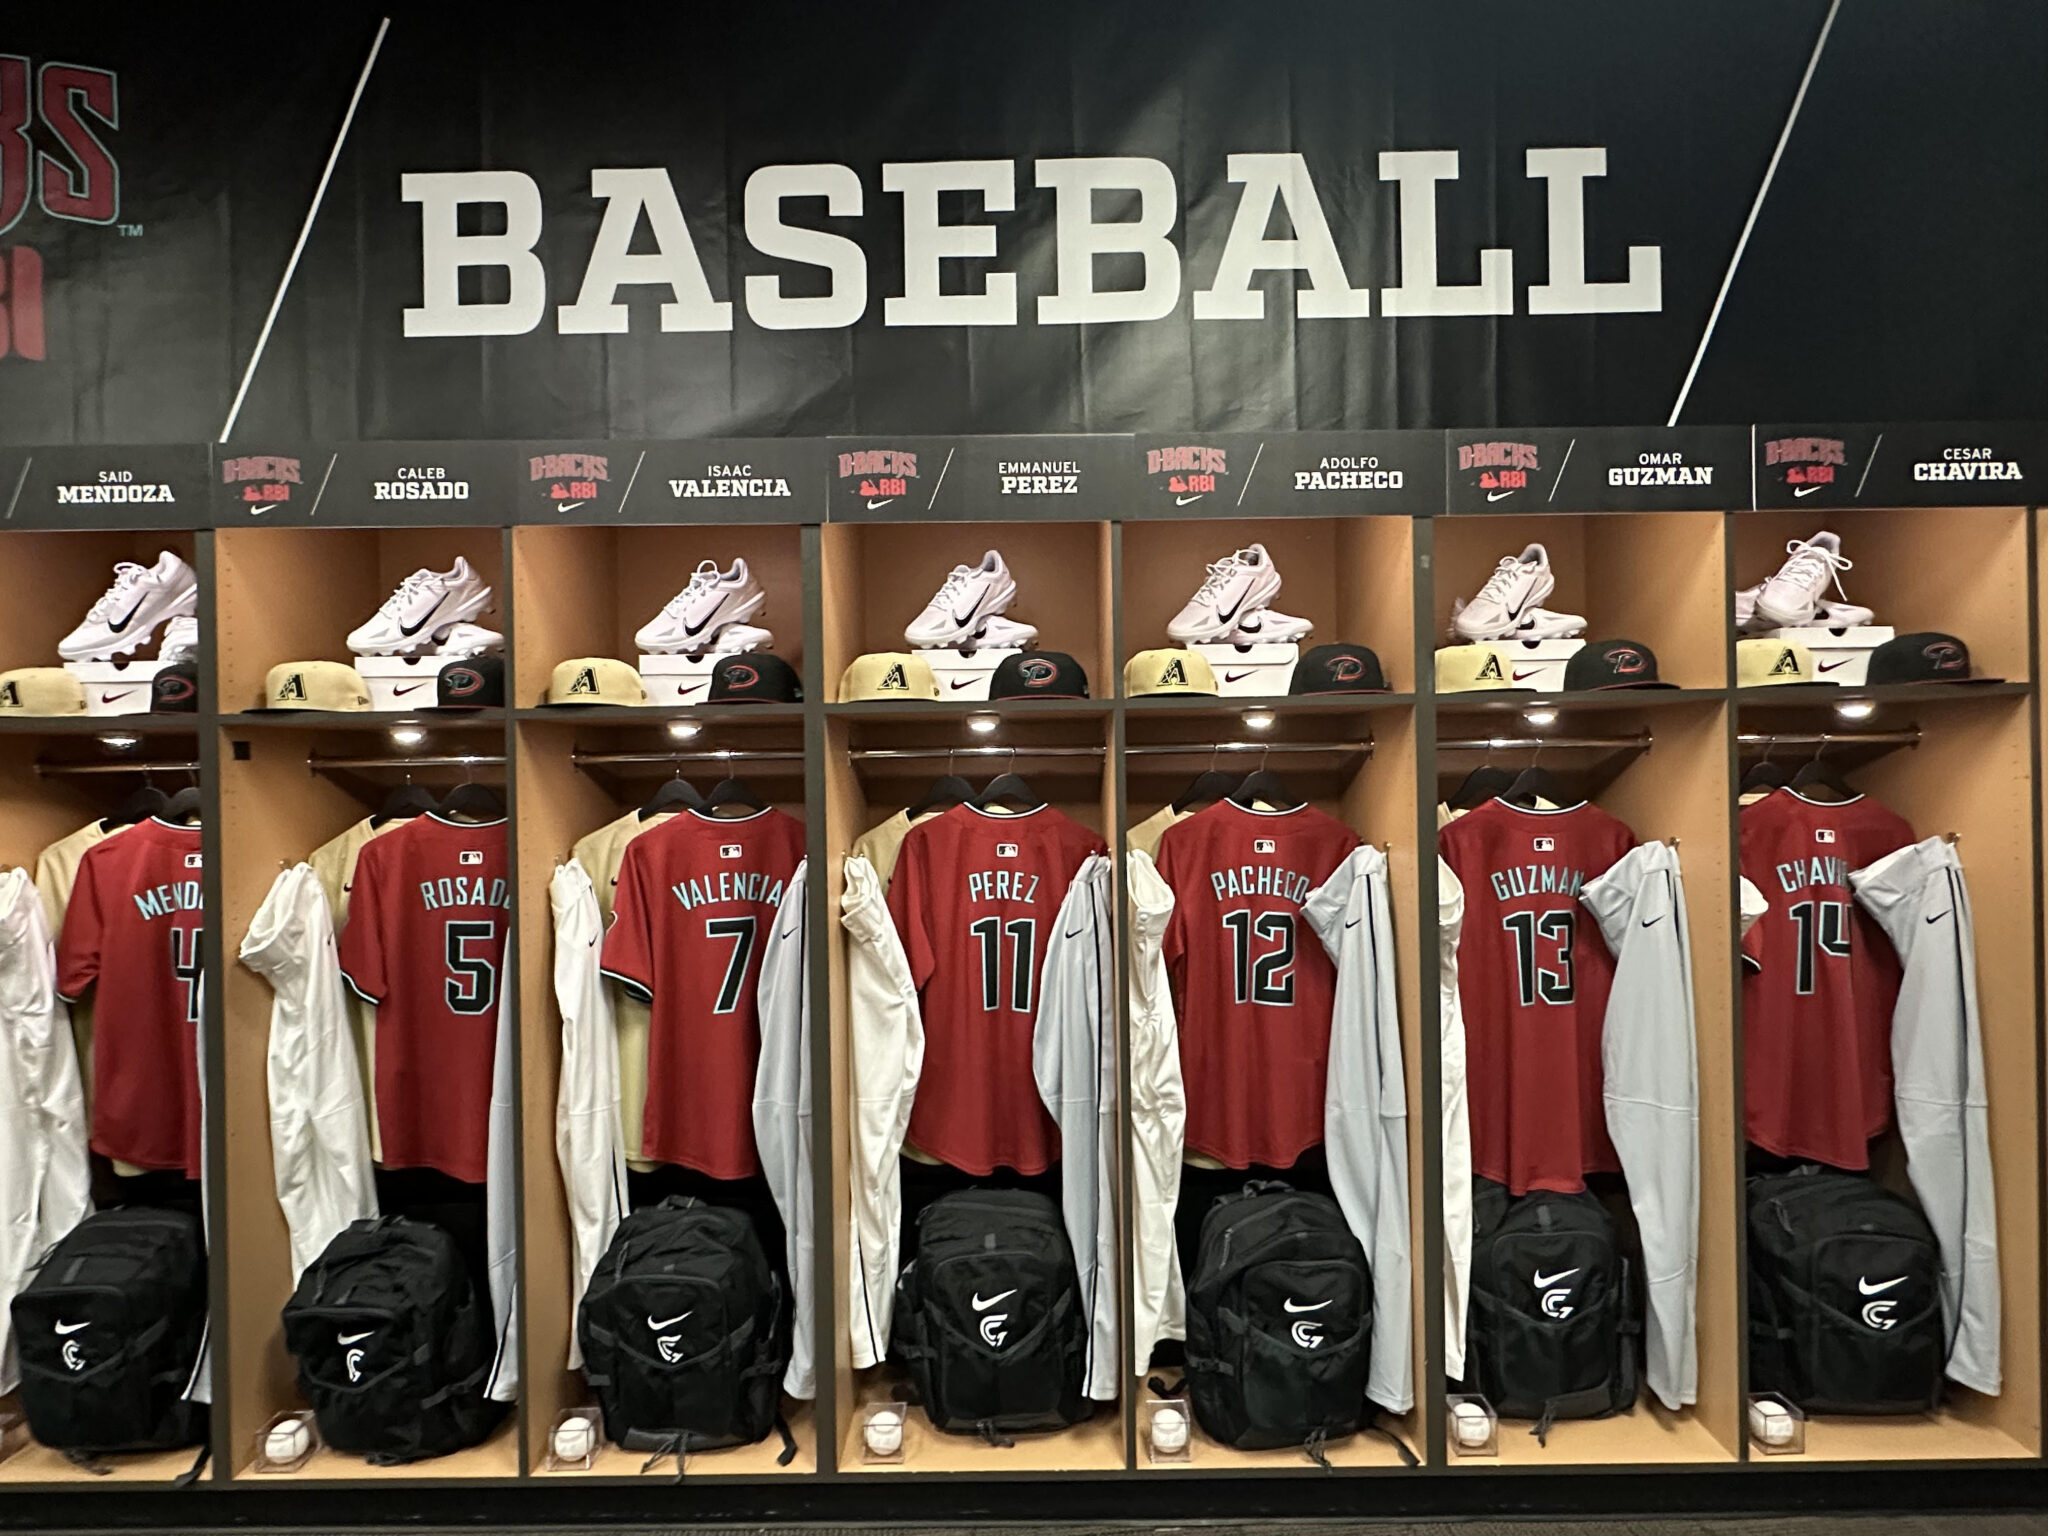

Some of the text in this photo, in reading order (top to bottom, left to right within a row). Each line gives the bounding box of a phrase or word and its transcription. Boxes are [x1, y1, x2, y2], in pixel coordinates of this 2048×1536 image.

[118, 224, 144, 237] TM
[401, 147, 1662, 338] BASEBALL
[838, 450, 917, 479] D-BACKS
[998, 460, 1082, 474] EMMANUEL
[1147, 446, 1226, 475] D-BACKS
[1319, 456, 1379, 470] ADOLFO
[1458, 442, 1538, 471] D-BACKS
[1638, 452, 1682, 465] OMAR
[1943, 447, 1992, 460] CESAR
[98, 470, 133, 483] SAID
[397, 467, 446, 480] CALEB
[707, 464, 752, 477] ISAAC
[1187, 474, 1215, 492] RBI
[1294, 470, 1404, 490] PACHECO
[1499, 470, 1527, 488] RBI
[1608, 466, 1714, 486] GUZMAN
[1913, 461, 2023, 481] CHAVIRA
[56, 484, 176, 504] MENDOZA
[373, 481, 469, 500] ROSADO
[569, 481, 598, 499] RBI
[668, 478, 792, 498] VALENCIA
[879, 478, 907, 496] RBI
[1001, 475, 1078, 494] PEREZ
[1156, 657, 1188, 686] A
[1474, 652, 1505, 681] A
[1767, 646, 1801, 675] A
[566, 666, 600, 696] A
[876, 663, 911, 690] A
[419, 876, 511, 911] ROSAD
[671, 871, 783, 910] VALENCIA
[967, 870, 1040, 904] PEREZ
[1210, 865, 1310, 905] PACHECO
[1490, 864, 1585, 902] GUZMAN
[133, 880, 204, 921] MEND
[445, 920, 496, 1016] 5
[705, 915, 757, 1014] 7
[970, 916, 1036, 1014] 11
[1222, 909, 1296, 1007] 12
[1502, 909, 1576, 1007] 13
